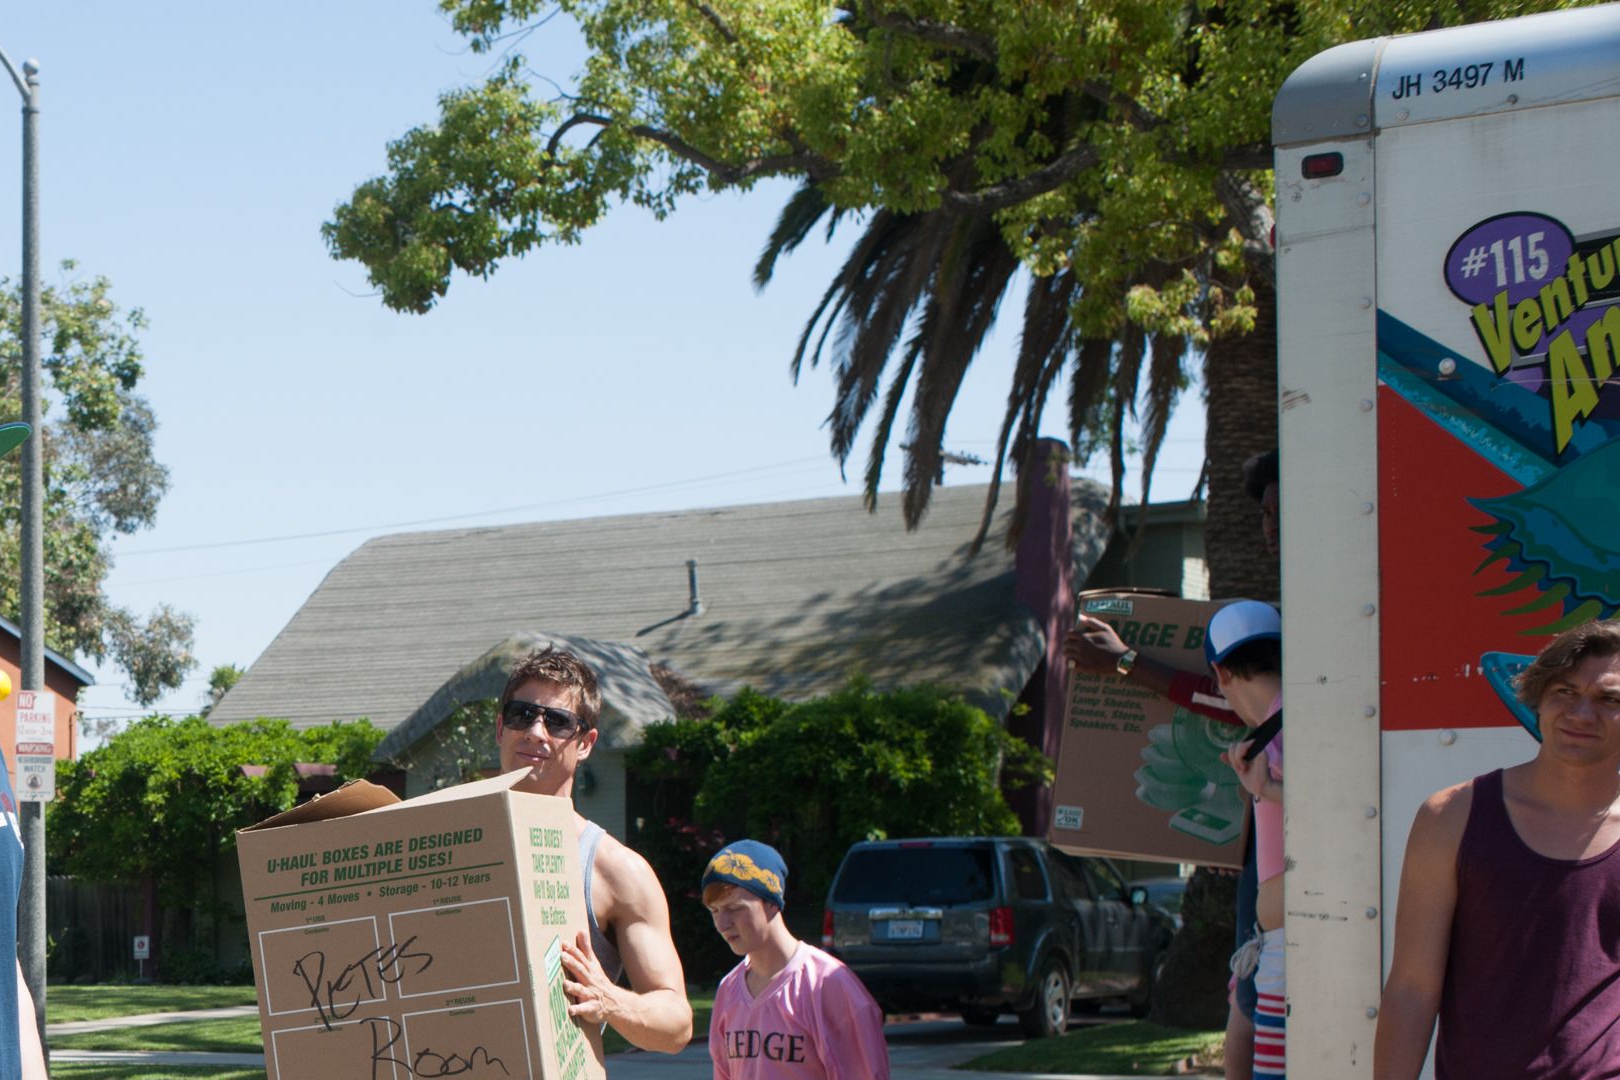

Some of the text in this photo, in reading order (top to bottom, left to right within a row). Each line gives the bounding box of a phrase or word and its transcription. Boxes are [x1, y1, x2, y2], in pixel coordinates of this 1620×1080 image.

[1392, 57, 1525, 100] JH 3497 M
[1460, 231, 1549, 287] #115
[1108, 620, 1179, 648] ARGE
[19, 693, 33, 708] NO
[322, 845, 369, 866] BOXES
[374, 839, 403, 858] ARE
[408, 828, 483, 850] DESIGNED
[301, 851, 453, 886] FOR MULTIPLE USES!
[271, 872, 491, 914] Moving 4 Moves Storage 10-12 Years
[726, 1030, 806, 1063] LEDGE
